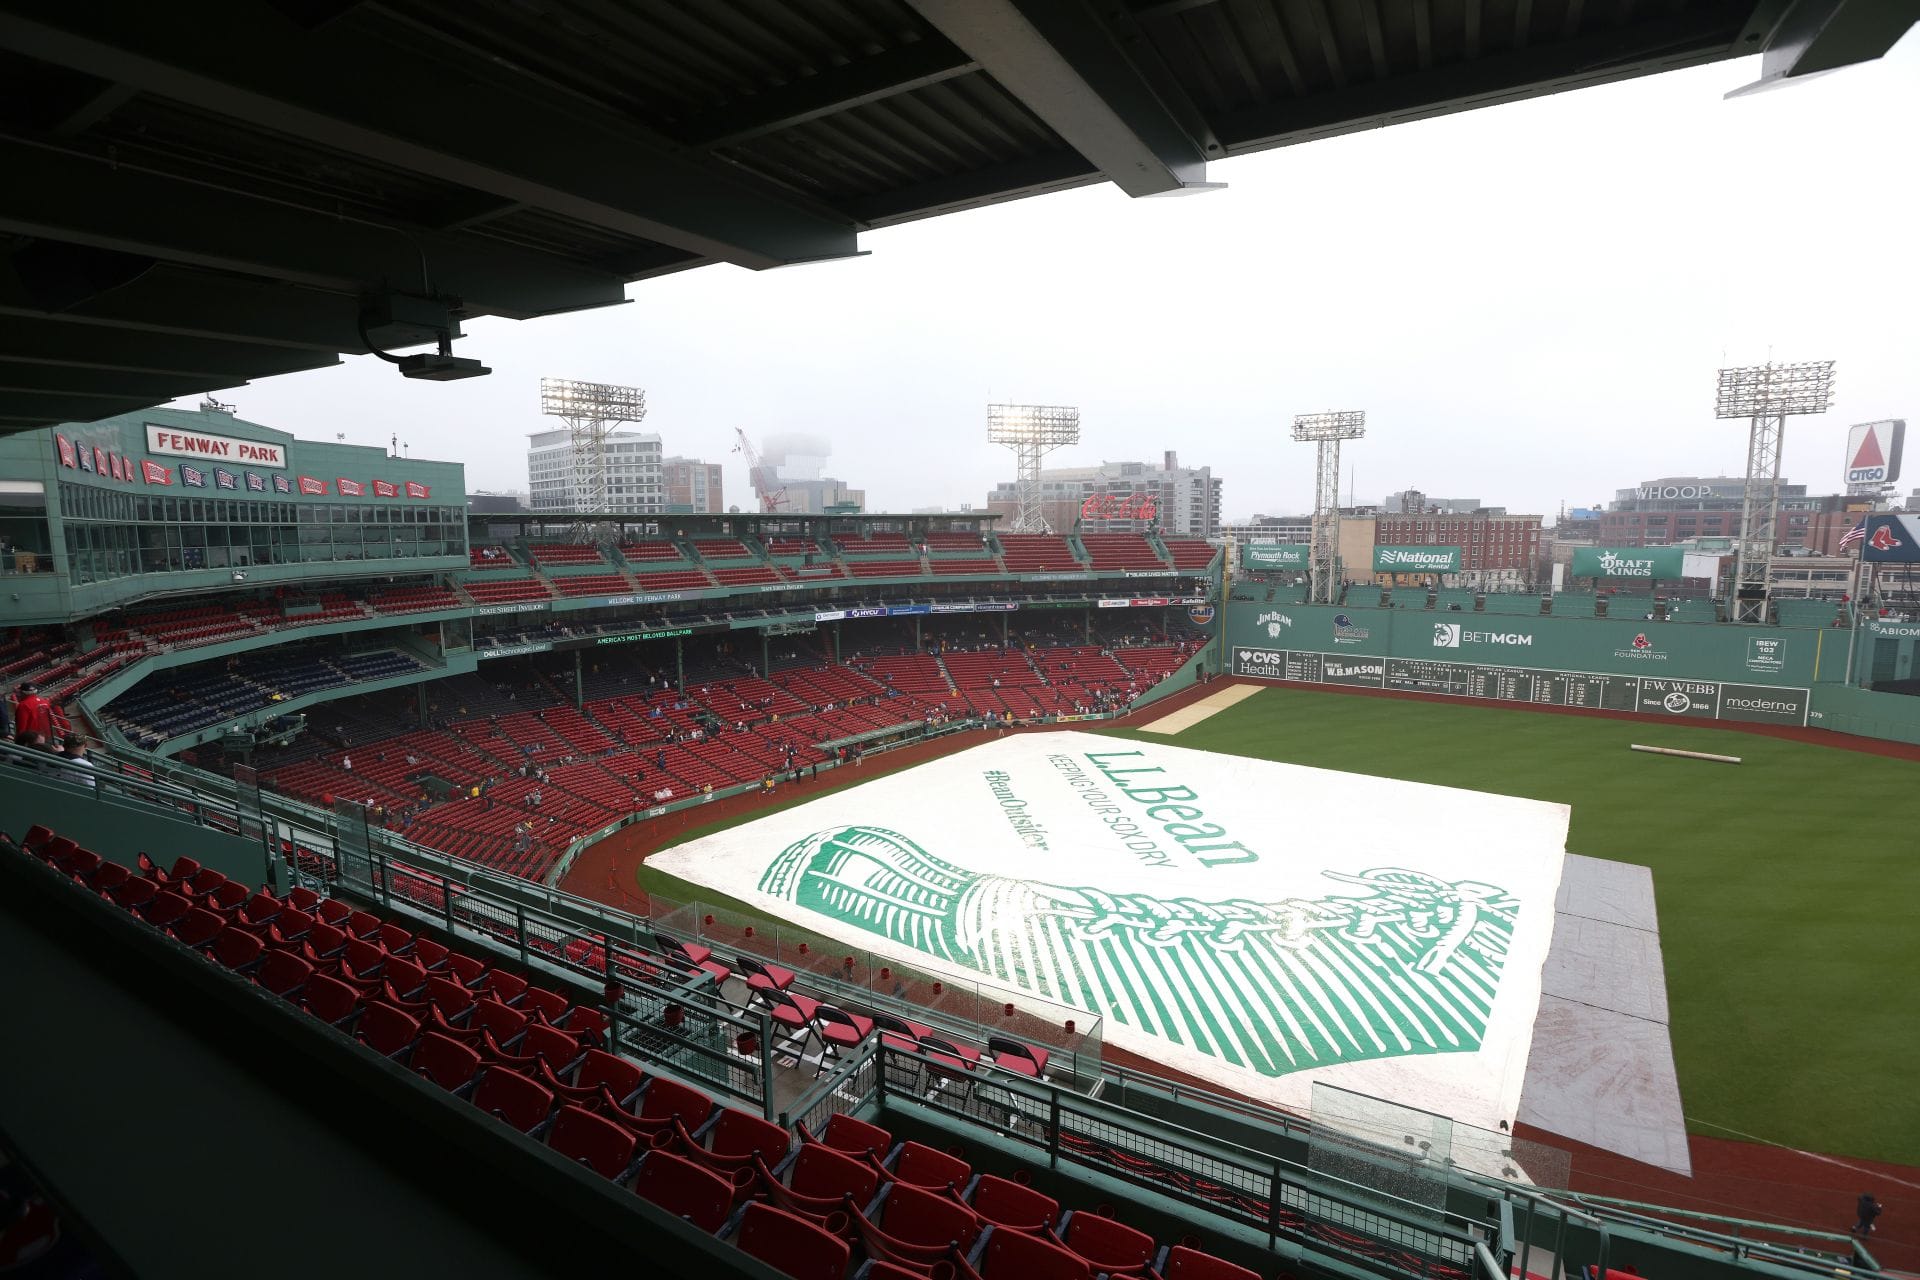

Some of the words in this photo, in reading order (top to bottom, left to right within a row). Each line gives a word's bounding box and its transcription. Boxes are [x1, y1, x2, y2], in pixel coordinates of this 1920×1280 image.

[157, 432, 230, 456] FENWAY
[239, 444, 279, 462] PARK
[1849, 468, 1884, 481] CITGO
[1635, 485, 1711, 499] WHOOP
[1251, 551, 1281, 561] Plymouth
[1283, 552, 1300, 560] Rock
[1601, 559, 1654, 568] DRAFT
[1606, 568, 1651, 576] KINGS
[608, 597, 634, 605] WELCOME
[645, 594, 666, 602] FENWAY
[1190, 607, 1214, 616] Gulf
[1257, 612, 1271, 625] JIM
[1271, 611, 1292, 627] BEAM
[597, 636, 626, 645] AMERICA'S
[642, 631, 666, 640] BELOVED
[667, 629, 692, 638] BALLPARK
[1463, 631, 1532, 645] BETMGM
[1252, 652, 1280, 664] CVS
[1615, 652, 1667, 660] FOUNDATION
[1240, 662, 1280, 676] Health
[1671, 682, 1715, 695] WEBB
[1643, 698, 1661, 706] Since
[1726, 697, 1798, 712] moderna
[1810, 711, 1823, 719] 379
[1046, 753, 1094, 793] KEEPING
[1077, 785, 1122, 817] YOUR
[1103, 816, 1144, 840] SOX
[1126, 841, 1179, 868] DRY
[1084, 750, 1259, 868] L.L.Bean
